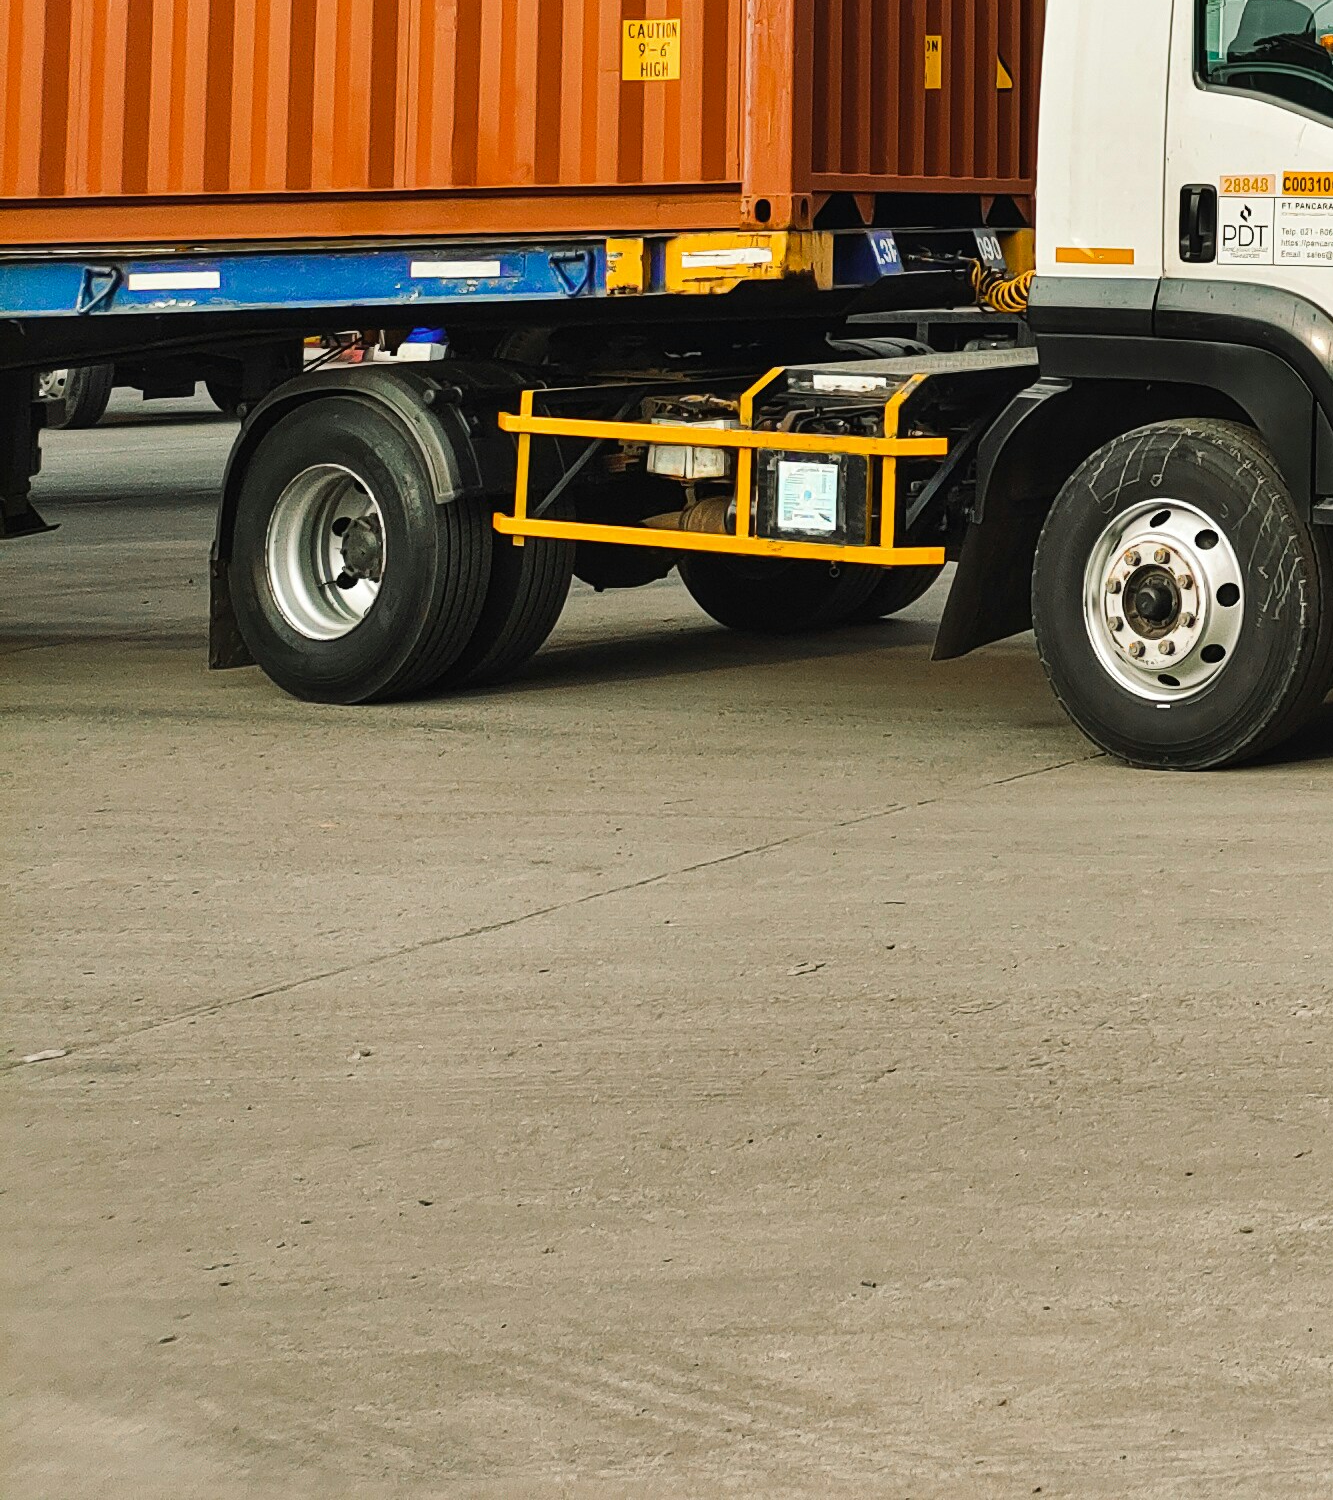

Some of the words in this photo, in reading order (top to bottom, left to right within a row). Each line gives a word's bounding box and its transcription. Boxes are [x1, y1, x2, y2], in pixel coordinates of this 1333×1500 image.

[627, 22, 678, 39] CAUTION
[640, 61, 669, 78] HIGH
[1222, 224, 1269, 247] PDT
